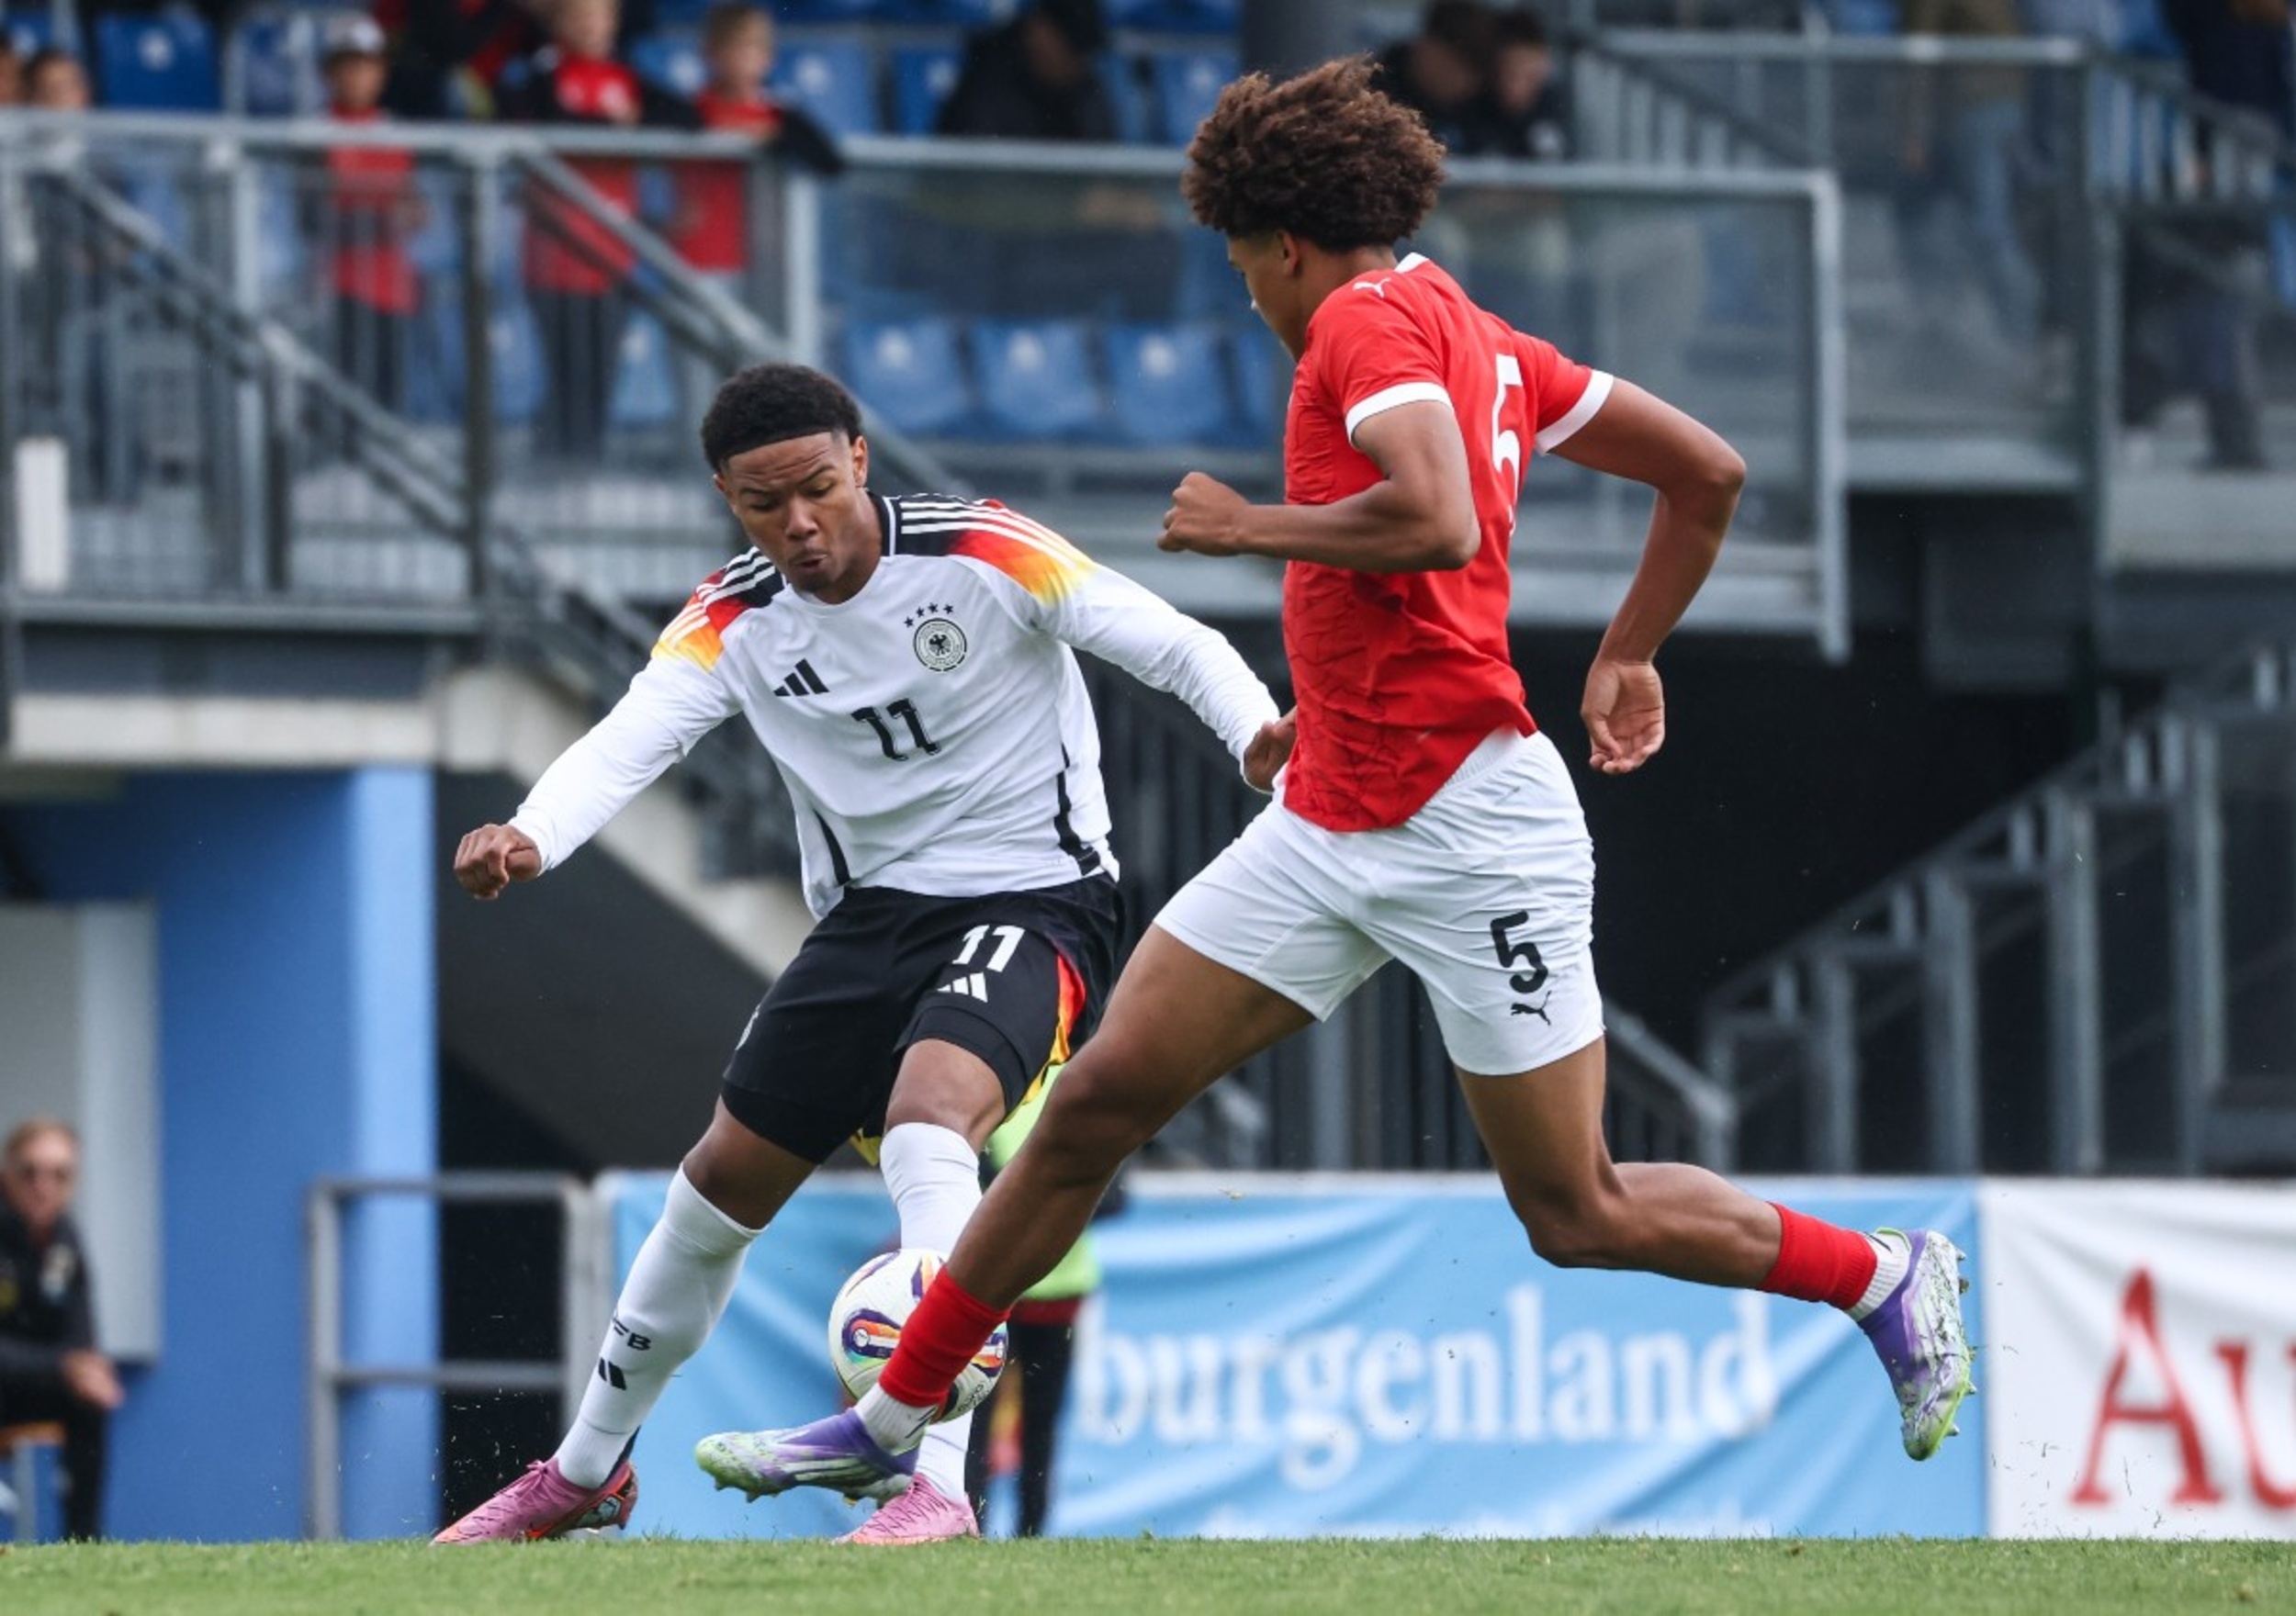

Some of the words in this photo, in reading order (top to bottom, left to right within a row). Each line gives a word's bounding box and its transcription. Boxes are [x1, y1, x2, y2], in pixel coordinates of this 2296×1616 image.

[1491, 353, 1524, 537] 5
[850, 698, 940, 761] 11
[951, 924, 1026, 972] 11
[1490, 910, 1548, 994] 5
[1074, 1284, 1780, 1491] burgenland
